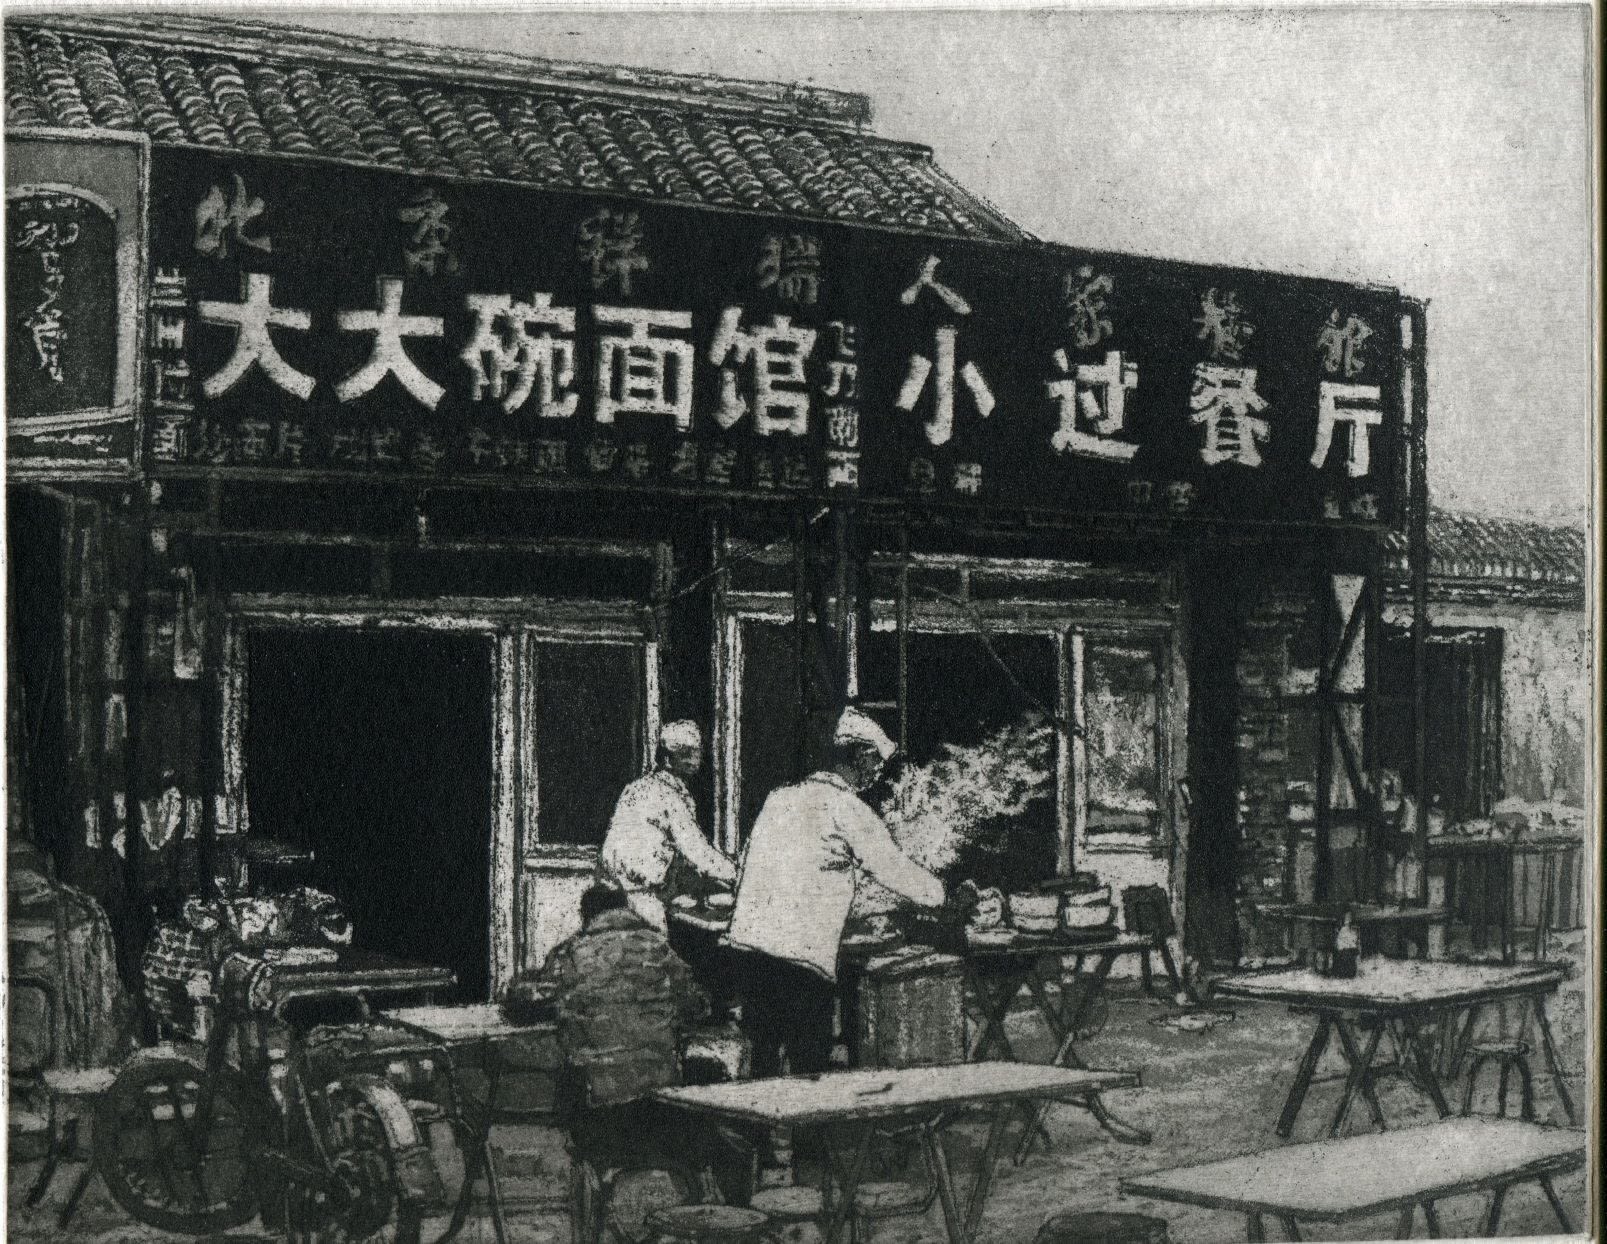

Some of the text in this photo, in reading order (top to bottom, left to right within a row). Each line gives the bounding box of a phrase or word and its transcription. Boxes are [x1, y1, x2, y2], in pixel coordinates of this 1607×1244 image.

[198, 270, 818, 438] 大大碗面馆
[895, 325, 1384, 479] 小过餐厅
